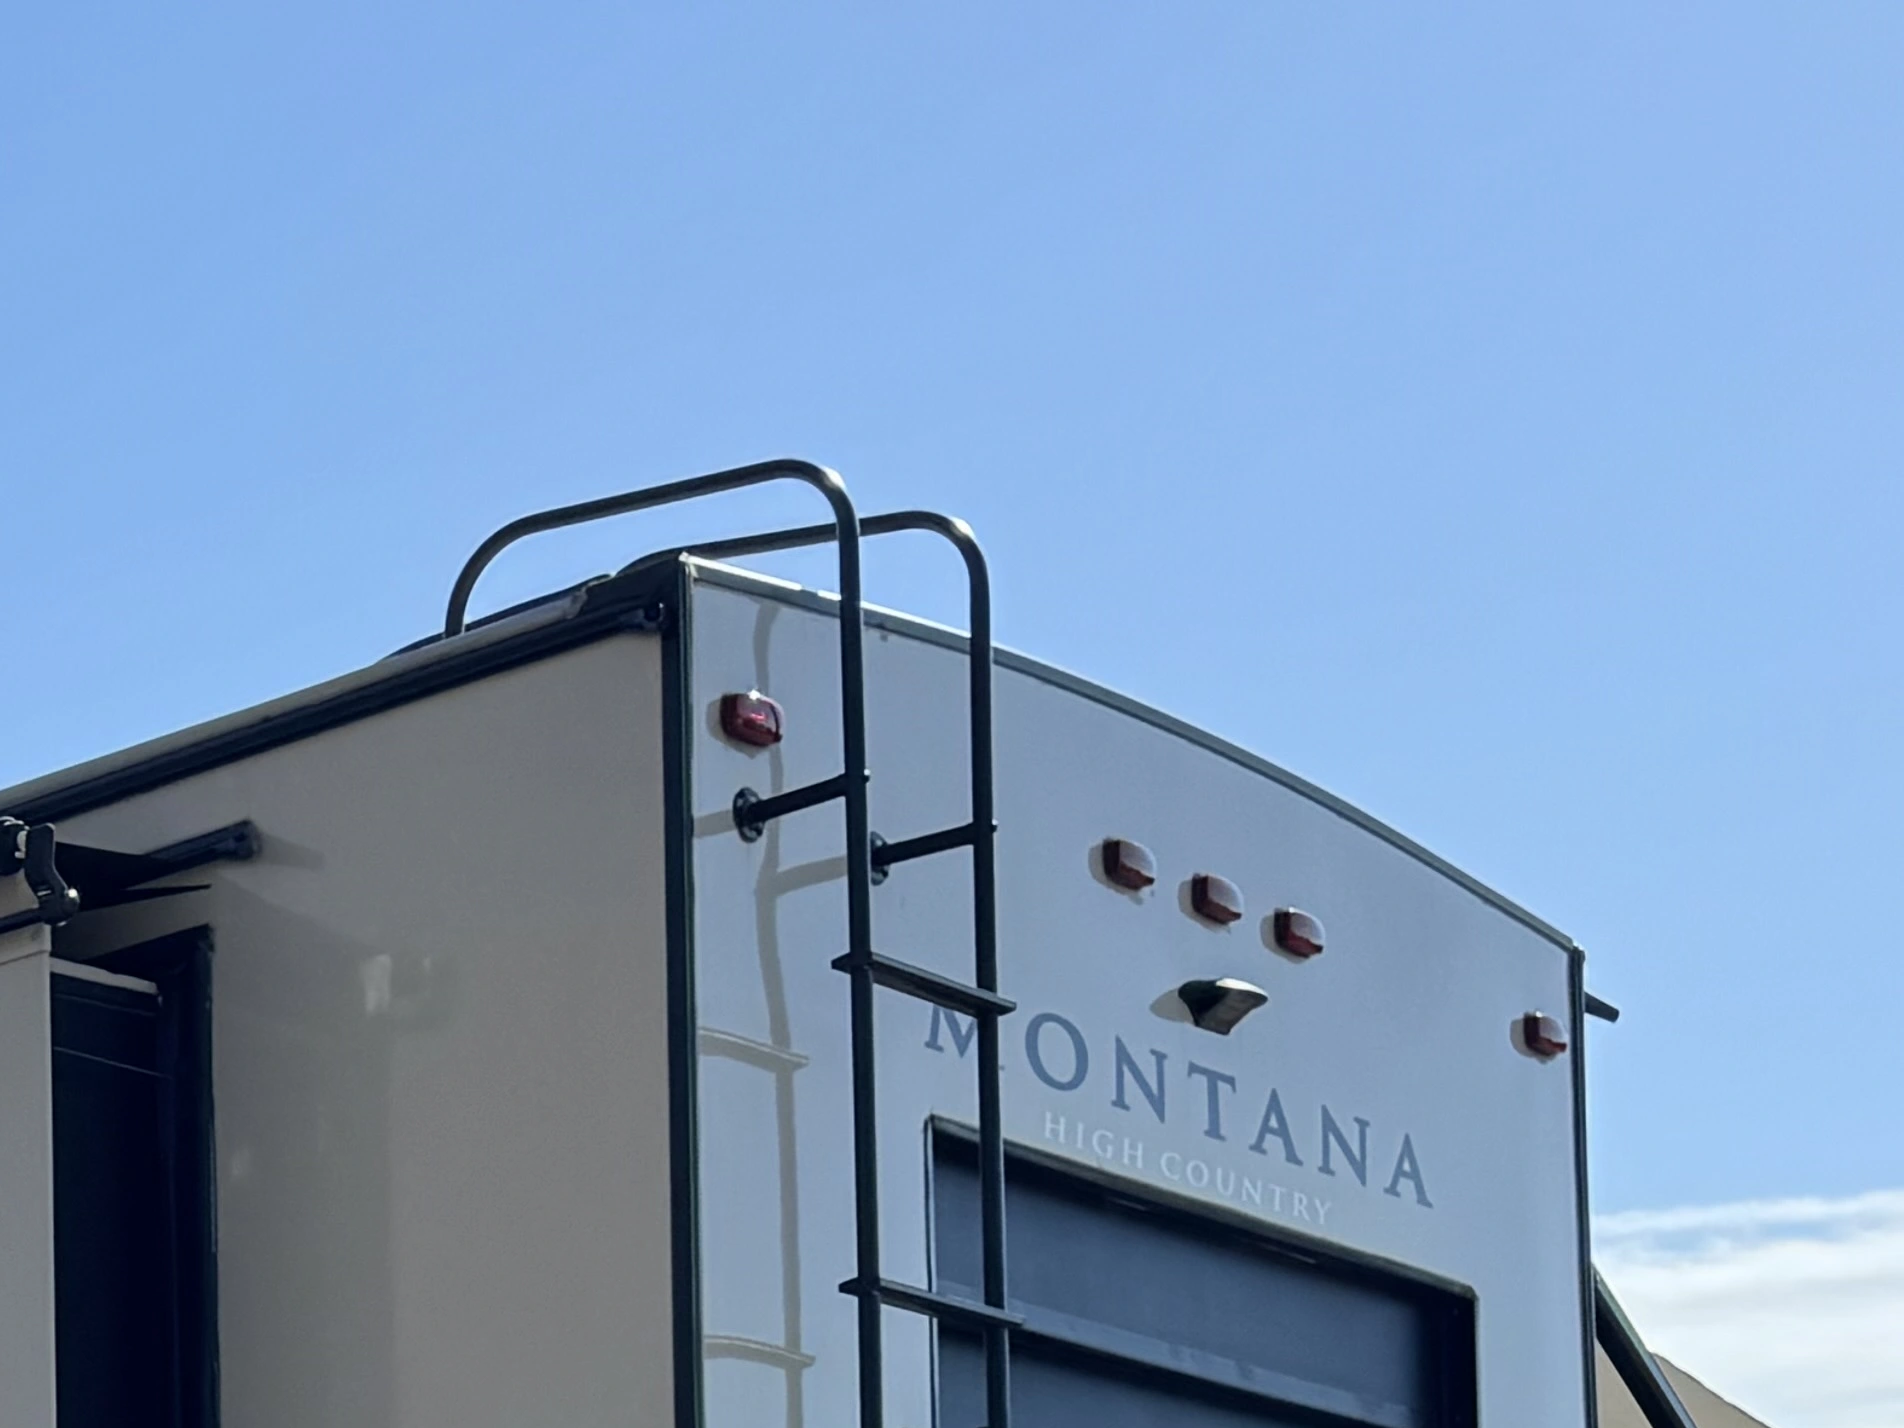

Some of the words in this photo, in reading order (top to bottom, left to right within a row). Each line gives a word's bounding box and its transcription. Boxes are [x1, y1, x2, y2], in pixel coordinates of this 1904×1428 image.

[923, 1003, 1435, 1210] MONTANA
[1043, 1110, 1145, 1168] HIGH
[1159, 1151, 1333, 1226] COUNTRY
